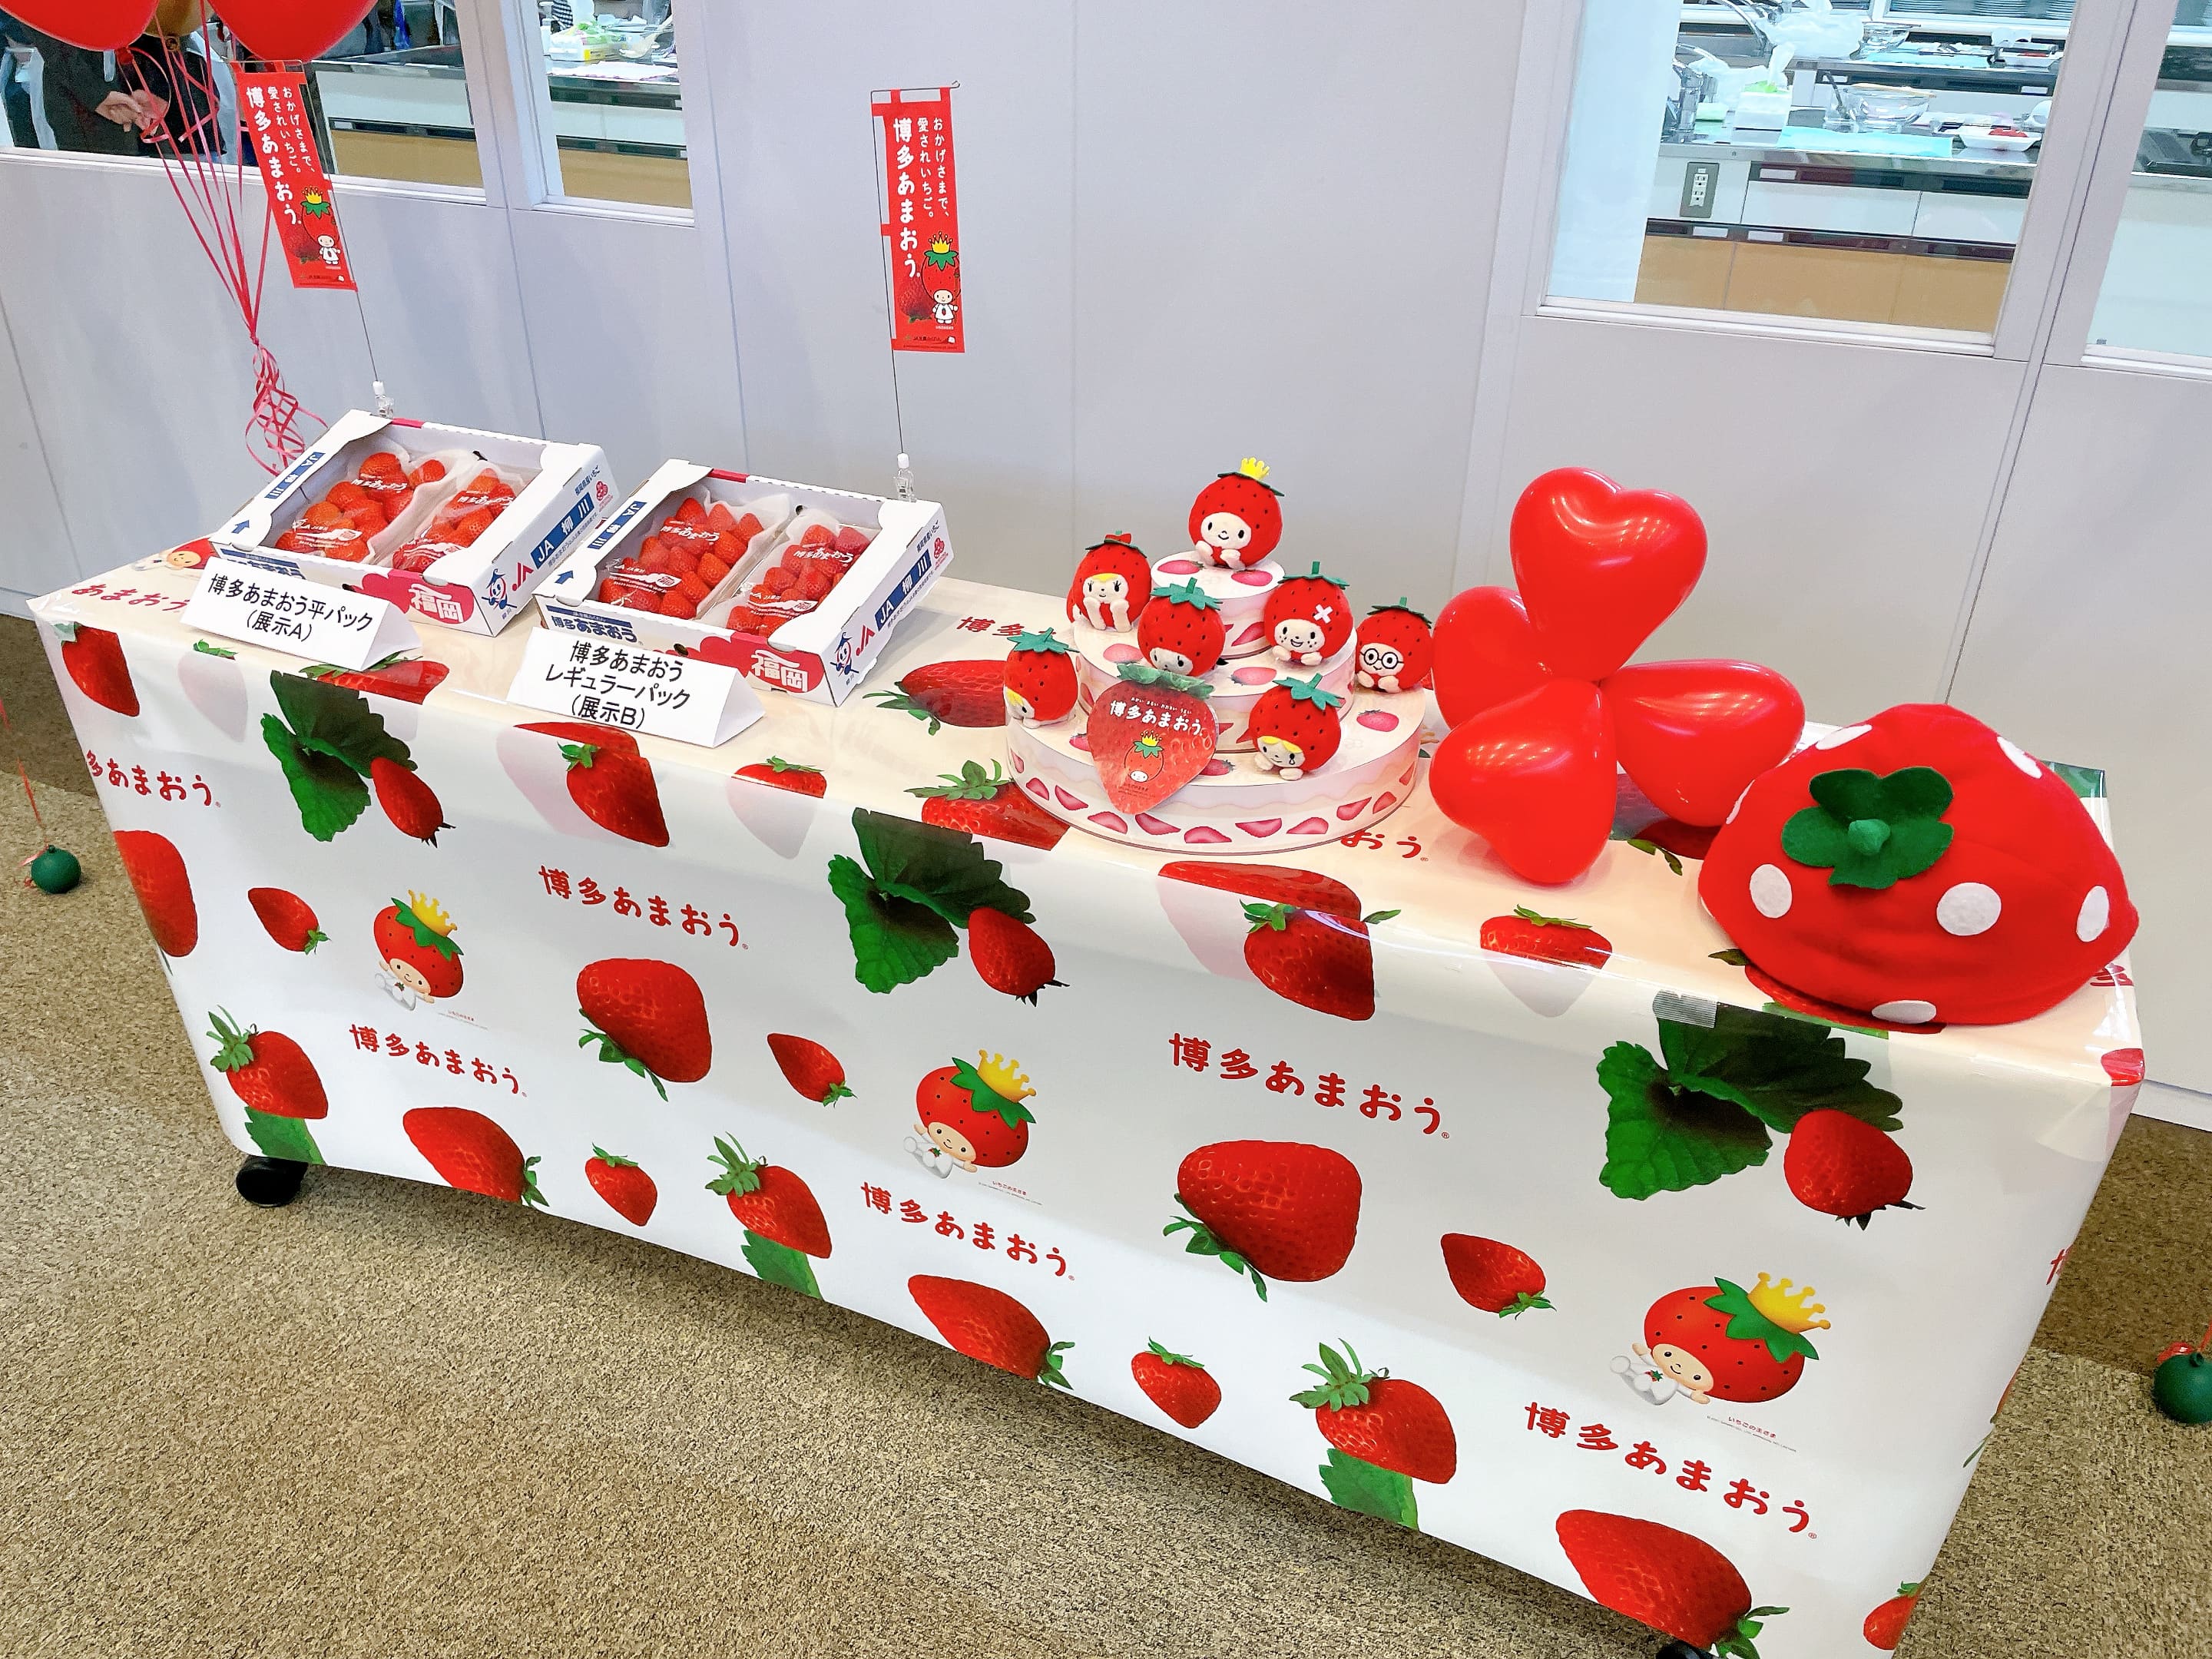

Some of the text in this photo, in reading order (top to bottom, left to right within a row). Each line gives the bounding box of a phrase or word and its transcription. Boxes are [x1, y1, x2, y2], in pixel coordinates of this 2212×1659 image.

[246, 86, 297, 226] 博多あまおう
[267, 85, 301, 174] 愛されいちご。
[282, 85, 316, 173] おかげさまで、
[917, 117, 934, 218] 愛されいちご。
[932, 116, 949, 217] おかげさまで、
[892, 118, 917, 278] 博多あまおう
[538, 539, 555, 562] JA
[207, 573, 374, 632] 博多あまおう平パック
[246, 609, 313, 642] （展示A）
[408, 583, 463, 624] 福岡
[551, 615, 637, 643] 博多あまおう
[879, 599, 895, 624] JA
[545, 664, 690, 710] レギュラーパック
[569, 640, 684, 683] 博多あまおう
[750, 648, 808, 692] 福岡
[571, 693, 646, 730] （展示B）
[1110, 700, 1202, 736] 博多あまおう
[538, 865, 740, 947] 博多あまおう
[349, 1024, 518, 1094] 博多あまおう
[1168, 1032, 1441, 1135] 博多あまおう
[860, 1181, 1067, 1277] 博多あまおう
[1728, 1416, 1777, 1439] いちごの王さま
[1525, 1402, 1810, 1533] 博多あまおう
